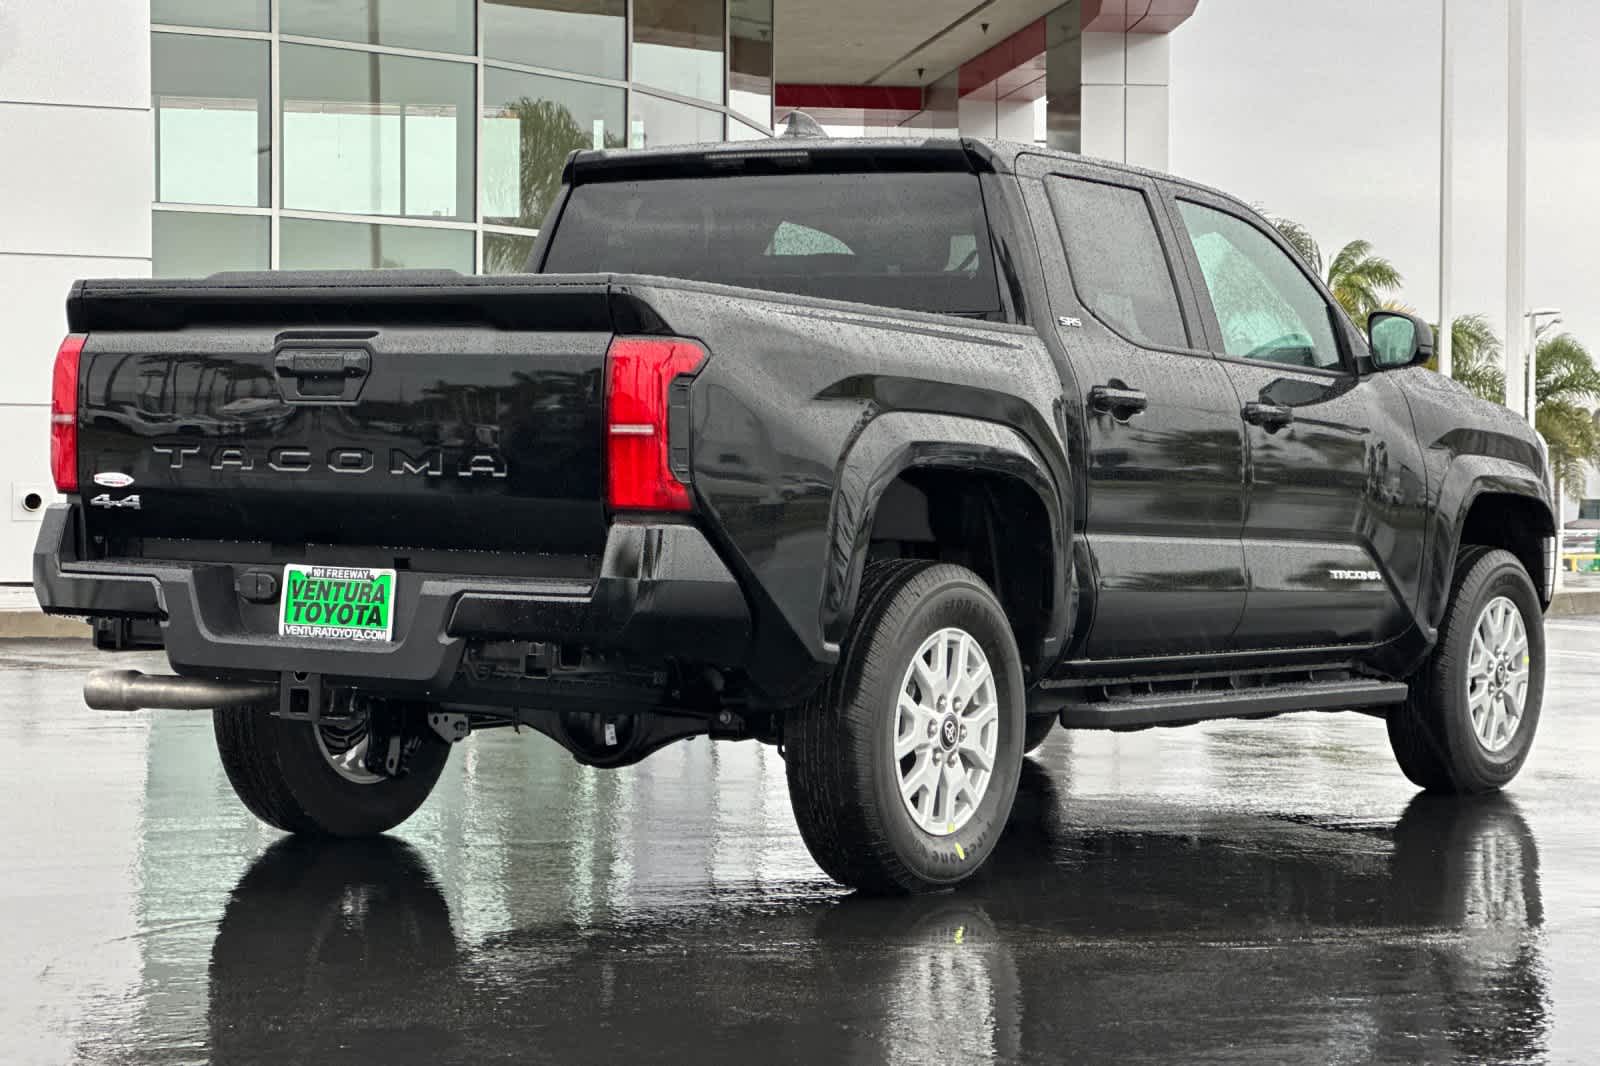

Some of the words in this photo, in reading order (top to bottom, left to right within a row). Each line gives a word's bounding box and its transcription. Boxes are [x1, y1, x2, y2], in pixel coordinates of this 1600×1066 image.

[151, 444, 509, 478] TACOMA
[312, 568, 325, 578] 101
[326, 568, 370, 578] FREEWAY
[1328, 569, 1382, 580] TACOMA
[291, 579, 386, 605] VENTURA
[293, 601, 383, 627] TOYOTA
[285, 625, 386, 639] VENTURATOYOTA.COM
